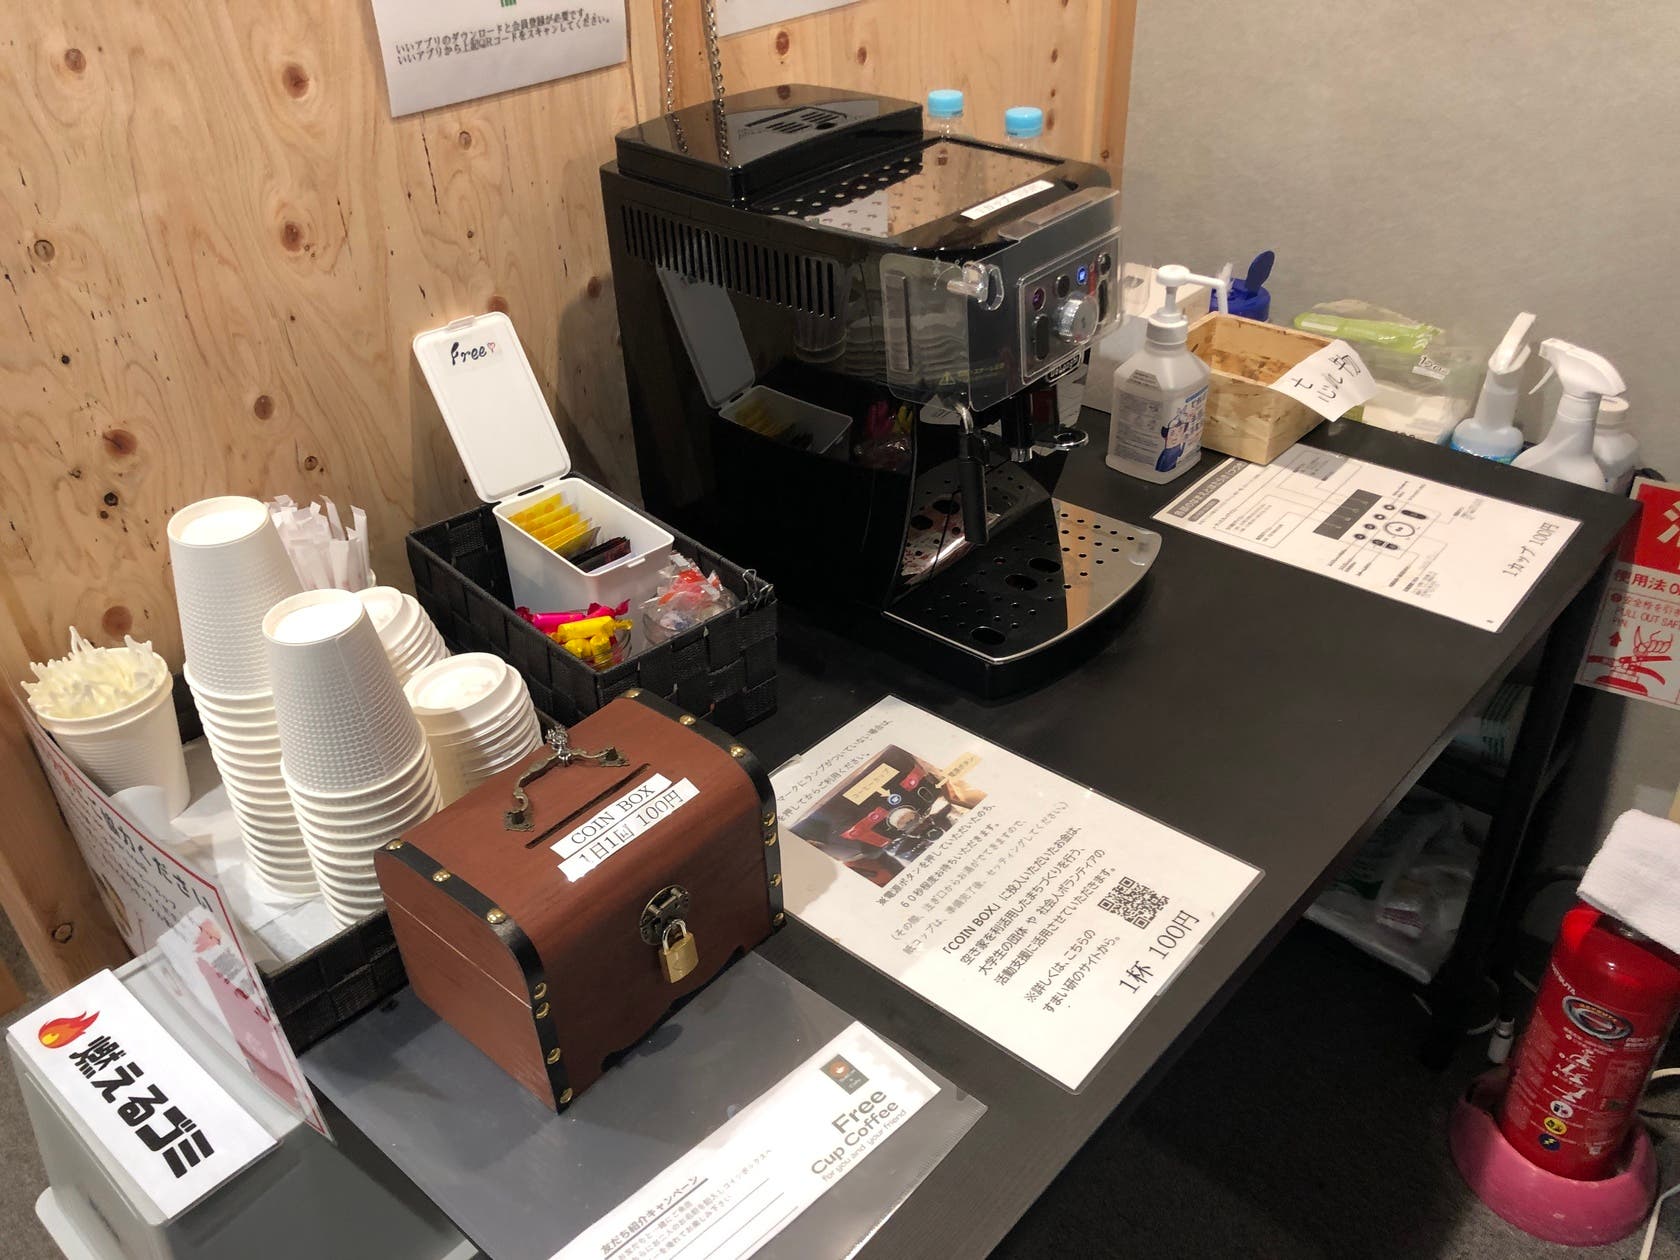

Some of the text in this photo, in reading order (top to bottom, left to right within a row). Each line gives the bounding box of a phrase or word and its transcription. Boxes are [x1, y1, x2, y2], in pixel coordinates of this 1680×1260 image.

[1502, 522, 1560, 576] 1カップ 100円
[571, 785, 656, 845] COIN BOX
[579, 789, 684, 864] 1日1回 100円
[874, 802, 998, 905] ※電源ボタンを押していただいたのち、
[957, 844, 1086, 965] 空き家を利活用したまちづくりを行う、
[975, 925, 1030, 976] 大学生の団体
[1034, 848, 1107, 915] 社会人ボランティアの
[992, 864, 1116, 986] 活動支援に活用させていただきます。
[1022, 928, 1098, 1003] ※詳しくは、こちらの
[1040, 932, 1121, 1014] すまい研のサイトから。
[1115, 909, 1201, 995] 1杯 100円
[68, 1034, 215, 1179] 燃えるゴミ
[811, 1102, 899, 1174] Cup Coffee
[822, 1109, 907, 1181] for you and your friend
[832, 1090, 887, 1134] Free
[602, 1176, 698, 1255] 友だち紹介キャンペーン
